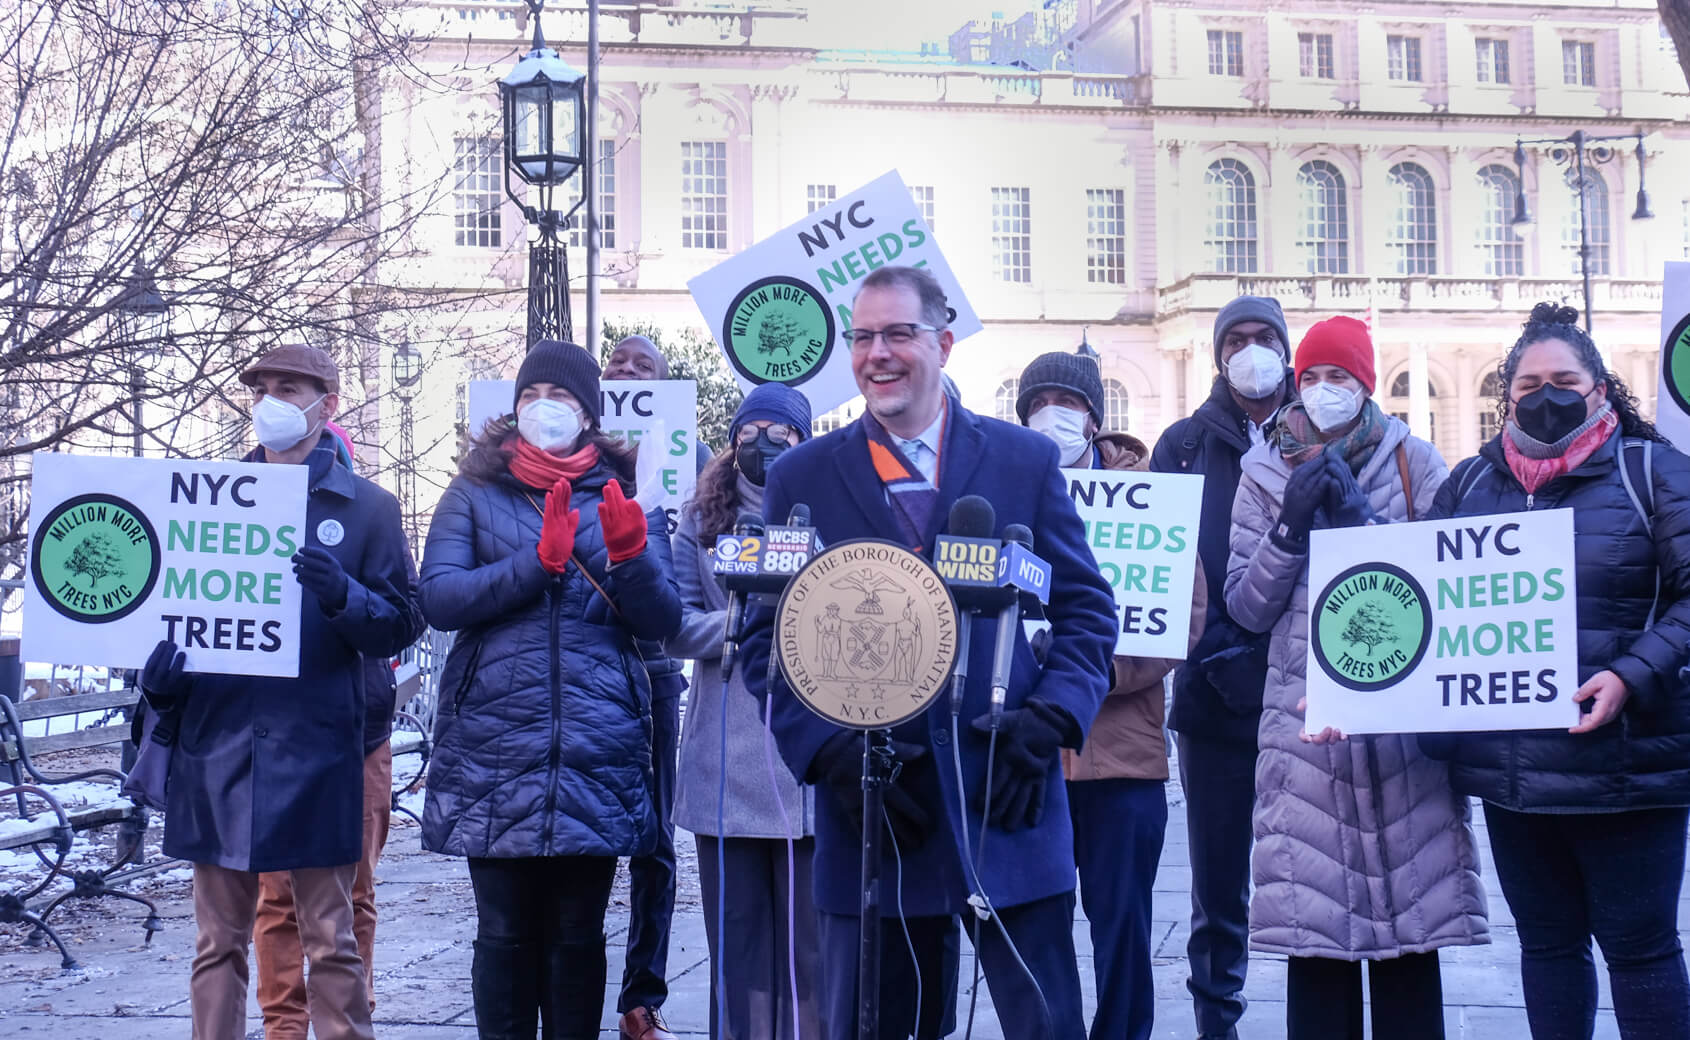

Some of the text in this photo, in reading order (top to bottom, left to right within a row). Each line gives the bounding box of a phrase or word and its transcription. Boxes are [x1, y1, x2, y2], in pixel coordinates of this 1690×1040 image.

[798, 200, 874, 257] NYC
[817, 219, 925, 293] NEEDS
[733, 287, 808, 336] MILLION MORE
[765, 339, 823, 377] TREES NYC
[170, 472, 258, 508] NYC
[1070, 480, 1152, 510] NYC
[49, 506, 148, 547] MILLION MORE
[167, 519, 297, 558] NEEDS
[769, 530, 810, 544] WCBS
[1085, 520, 1187, 553] EEDS
[1436, 523, 1521, 562] NYC
[714, 561, 757, 573] NEWS
[738, 538, 760, 562] 2
[764, 551, 808, 573] 880
[939, 541, 997, 564] 1010
[163, 567, 282, 605] MORE
[937, 561, 995, 581] WINS
[1019, 557, 1045, 588] NTD
[1098, 561, 1171, 594] ORE
[1437, 568, 1565, 610] NEEDS
[57, 580, 132, 611] TREES NYC
[1325, 575, 1417, 614] MILLION MORE
[161, 614, 282, 653] TREES
[784, 547, 953, 704] PRESIDENT OF THE BOROUGH OF MANHATTAN
[1436, 618, 1555, 658] MORE
[1336, 649, 1407, 678] TREES NYC
[1436, 668, 1558, 707] TREES
